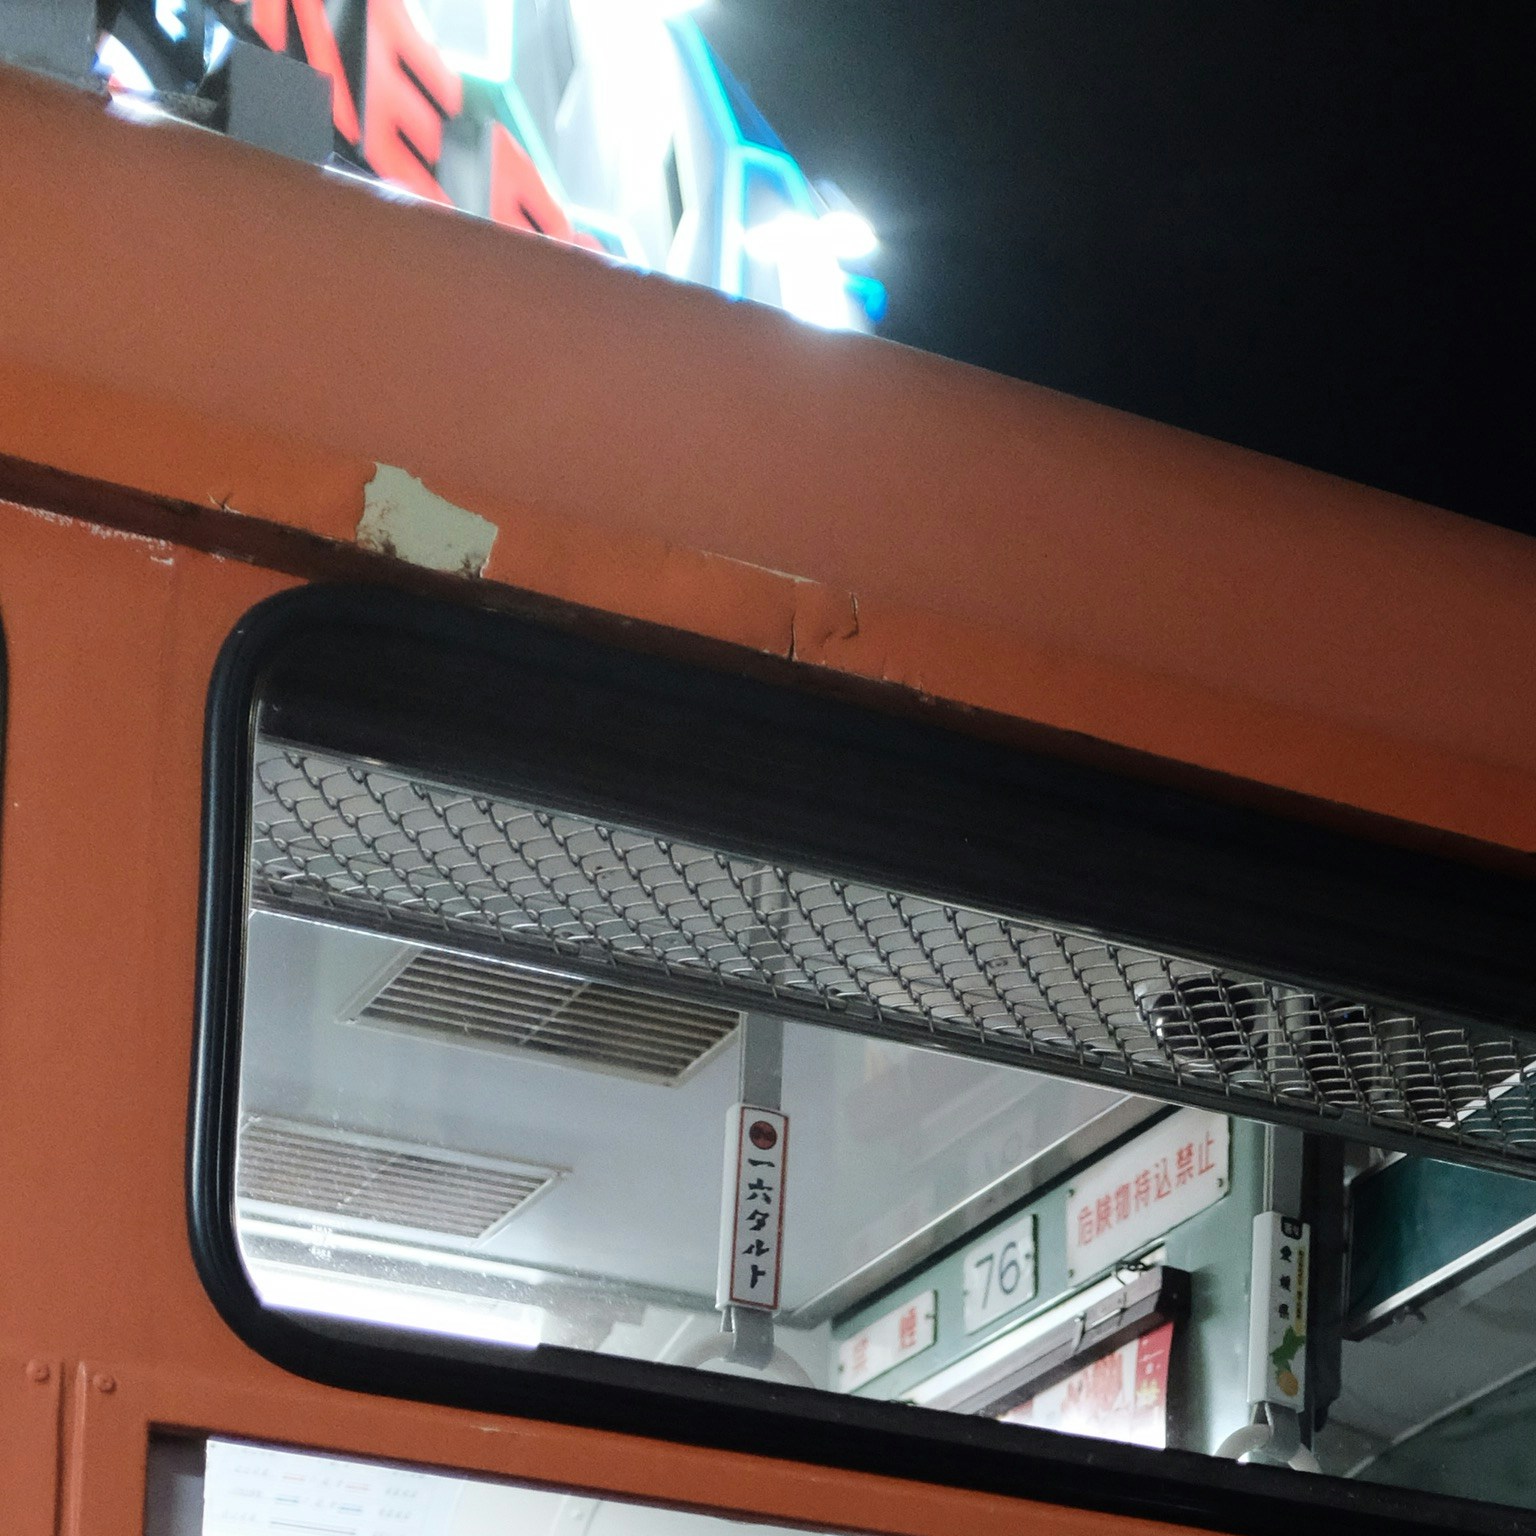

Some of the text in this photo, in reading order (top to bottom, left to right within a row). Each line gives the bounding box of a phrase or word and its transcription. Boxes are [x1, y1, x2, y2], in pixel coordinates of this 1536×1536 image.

[742, 1158, 776, 1289] 一六タルト
[1076, 1131, 1216, 1247] 危険物持込禁止
[975, 1240, 1021, 1311] 76
